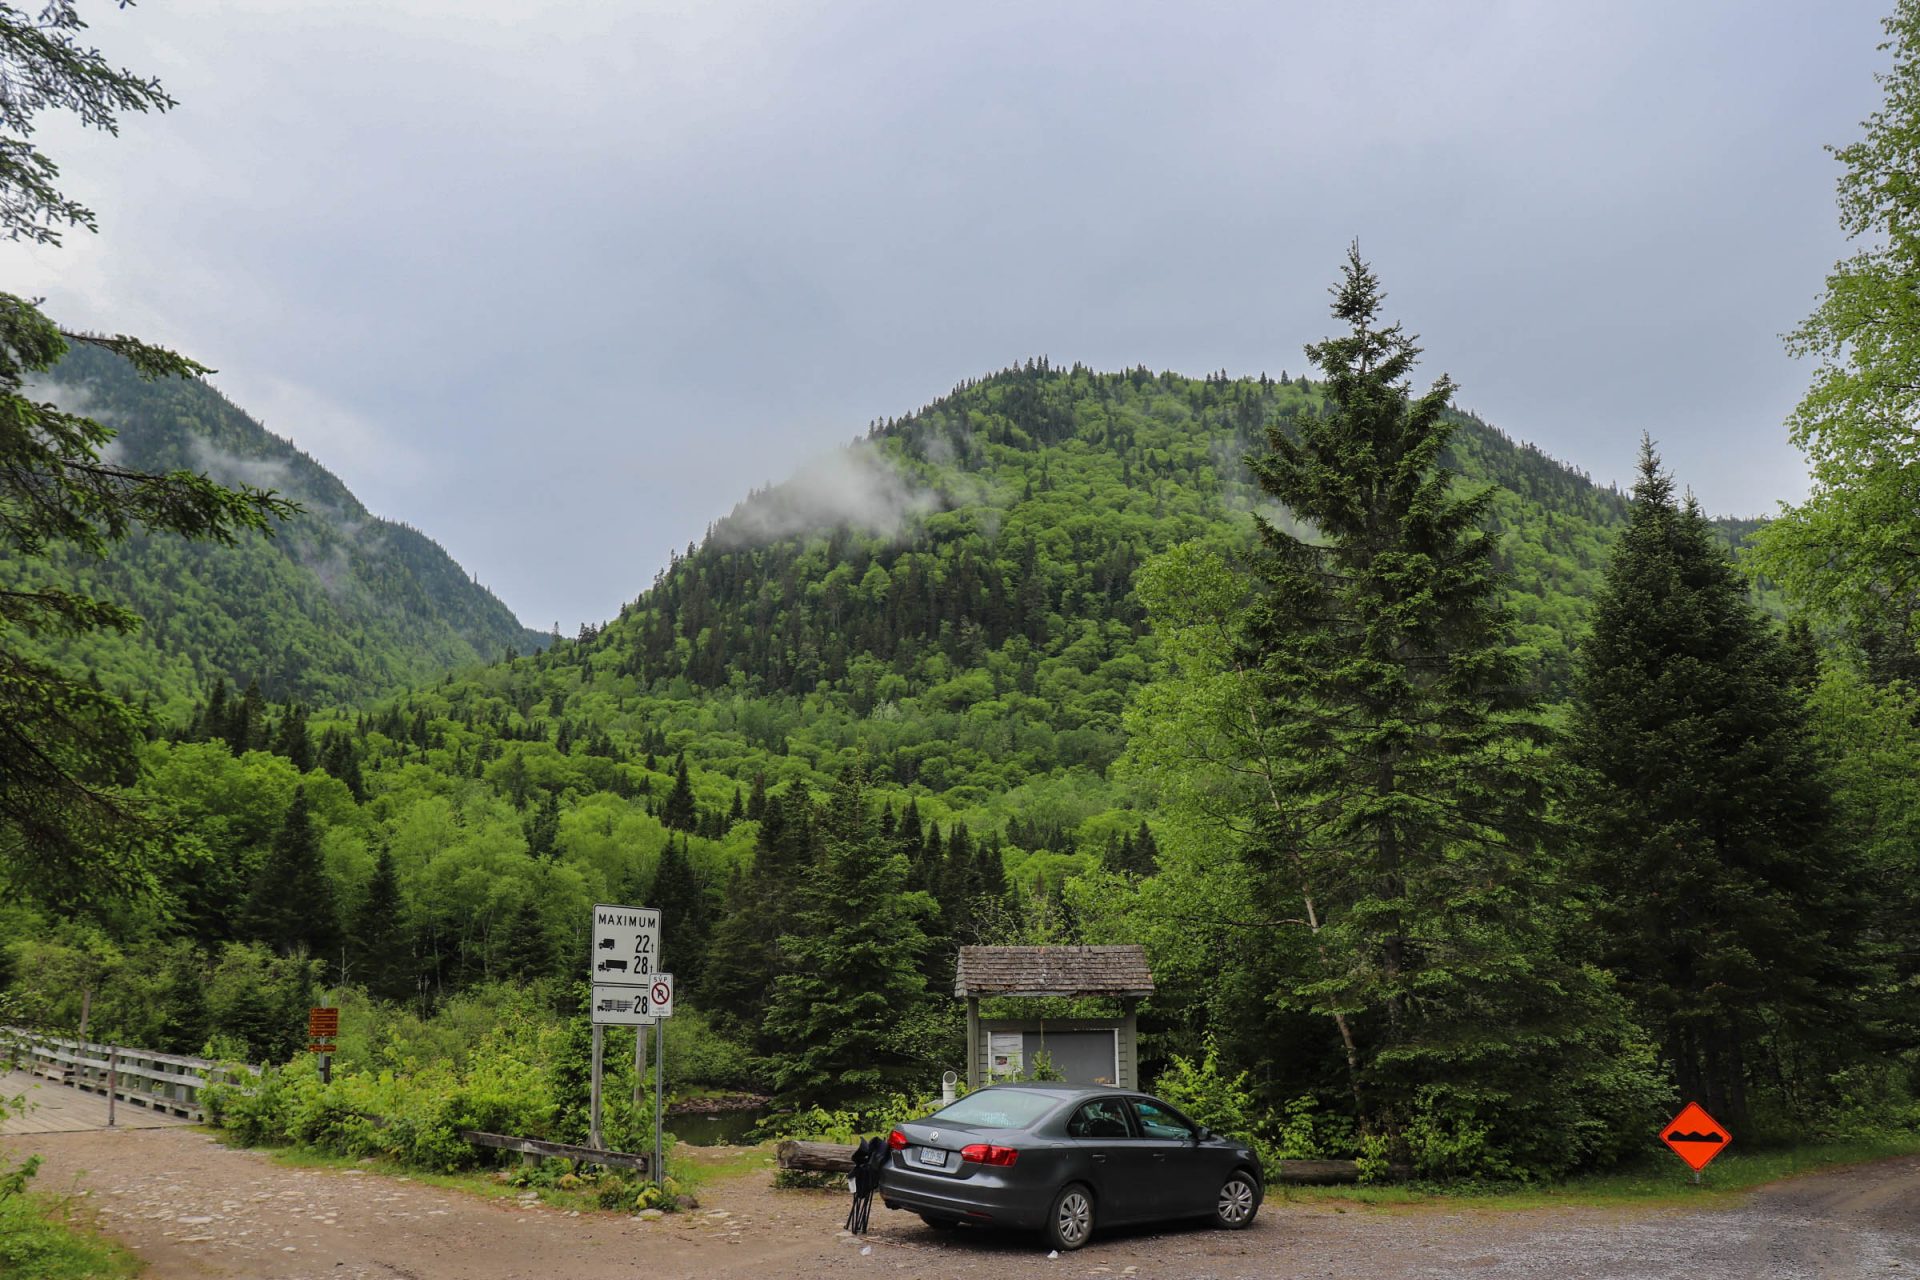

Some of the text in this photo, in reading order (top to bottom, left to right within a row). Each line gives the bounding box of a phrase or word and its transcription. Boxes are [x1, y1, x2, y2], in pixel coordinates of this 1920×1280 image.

[598, 913, 656, 929] MAXIMUM
[635, 934, 650, 954] 22
[634, 956, 648, 975] 28
[634, 995, 648, 1014] 28
